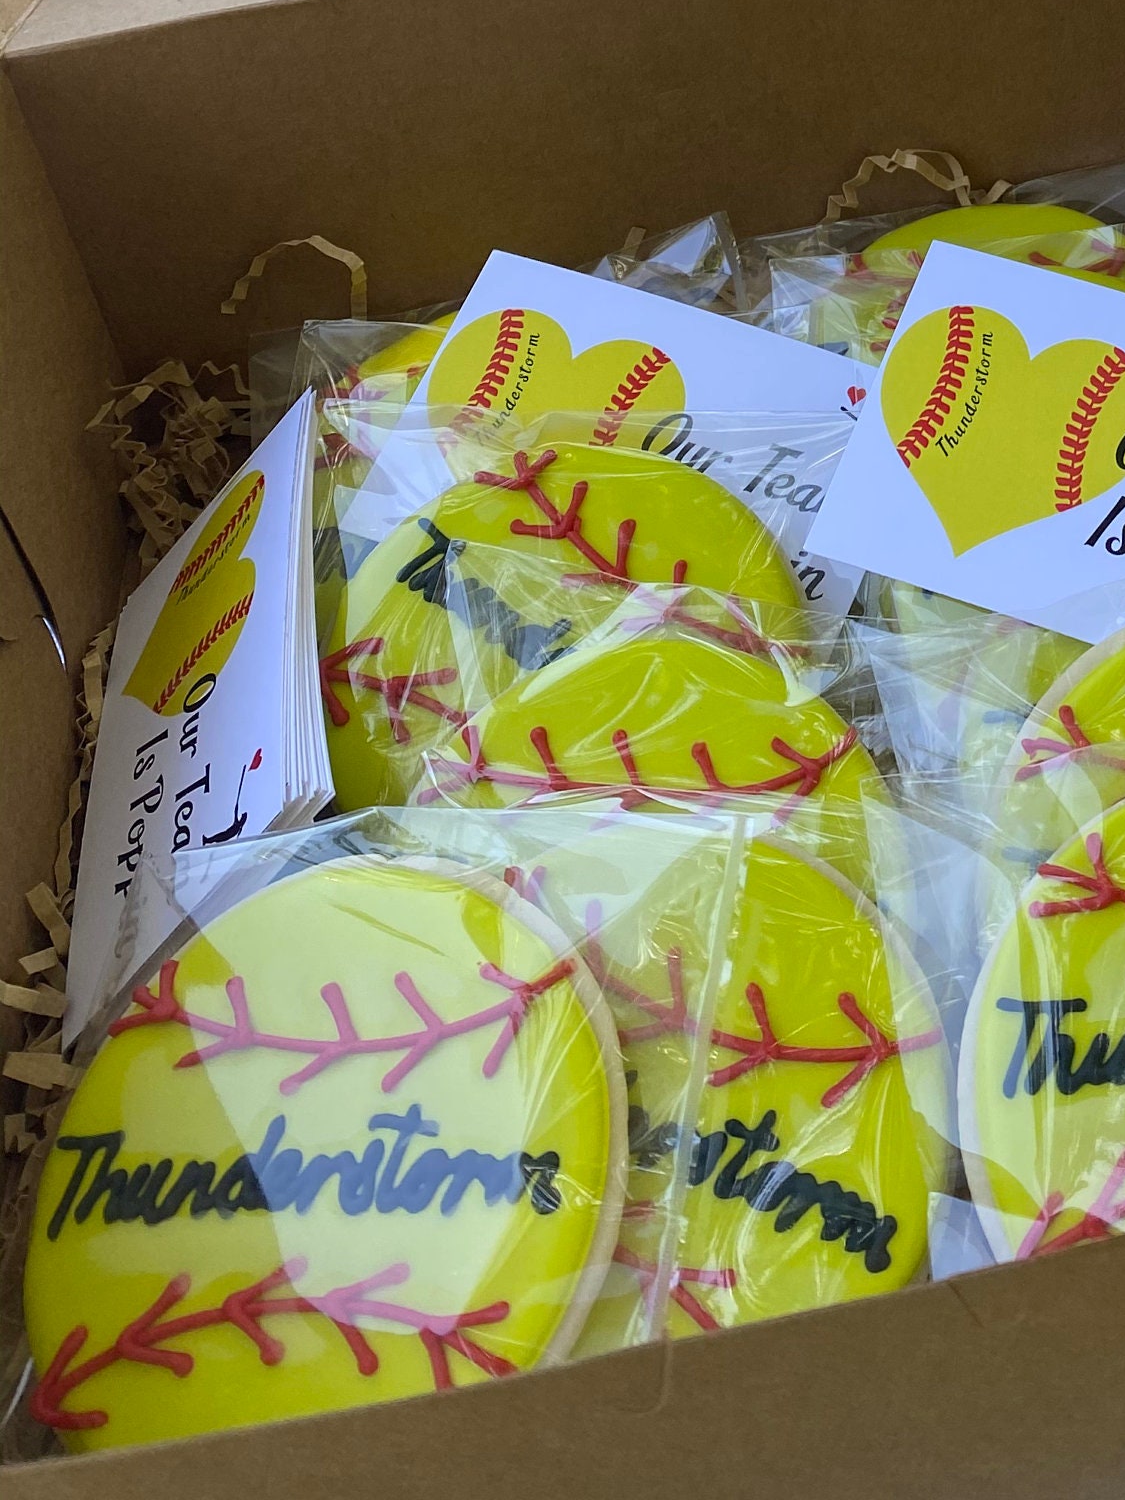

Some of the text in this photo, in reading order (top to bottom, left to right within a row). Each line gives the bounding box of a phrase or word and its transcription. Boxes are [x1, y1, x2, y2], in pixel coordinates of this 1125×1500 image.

[934, 330, 994, 458] Thunderstorm
[742, 443, 826, 514] Tea
[133, 728, 169, 781] Is
[179, 672, 217, 759] Our
[55, 1103, 561, 1242] Thunderstorm
